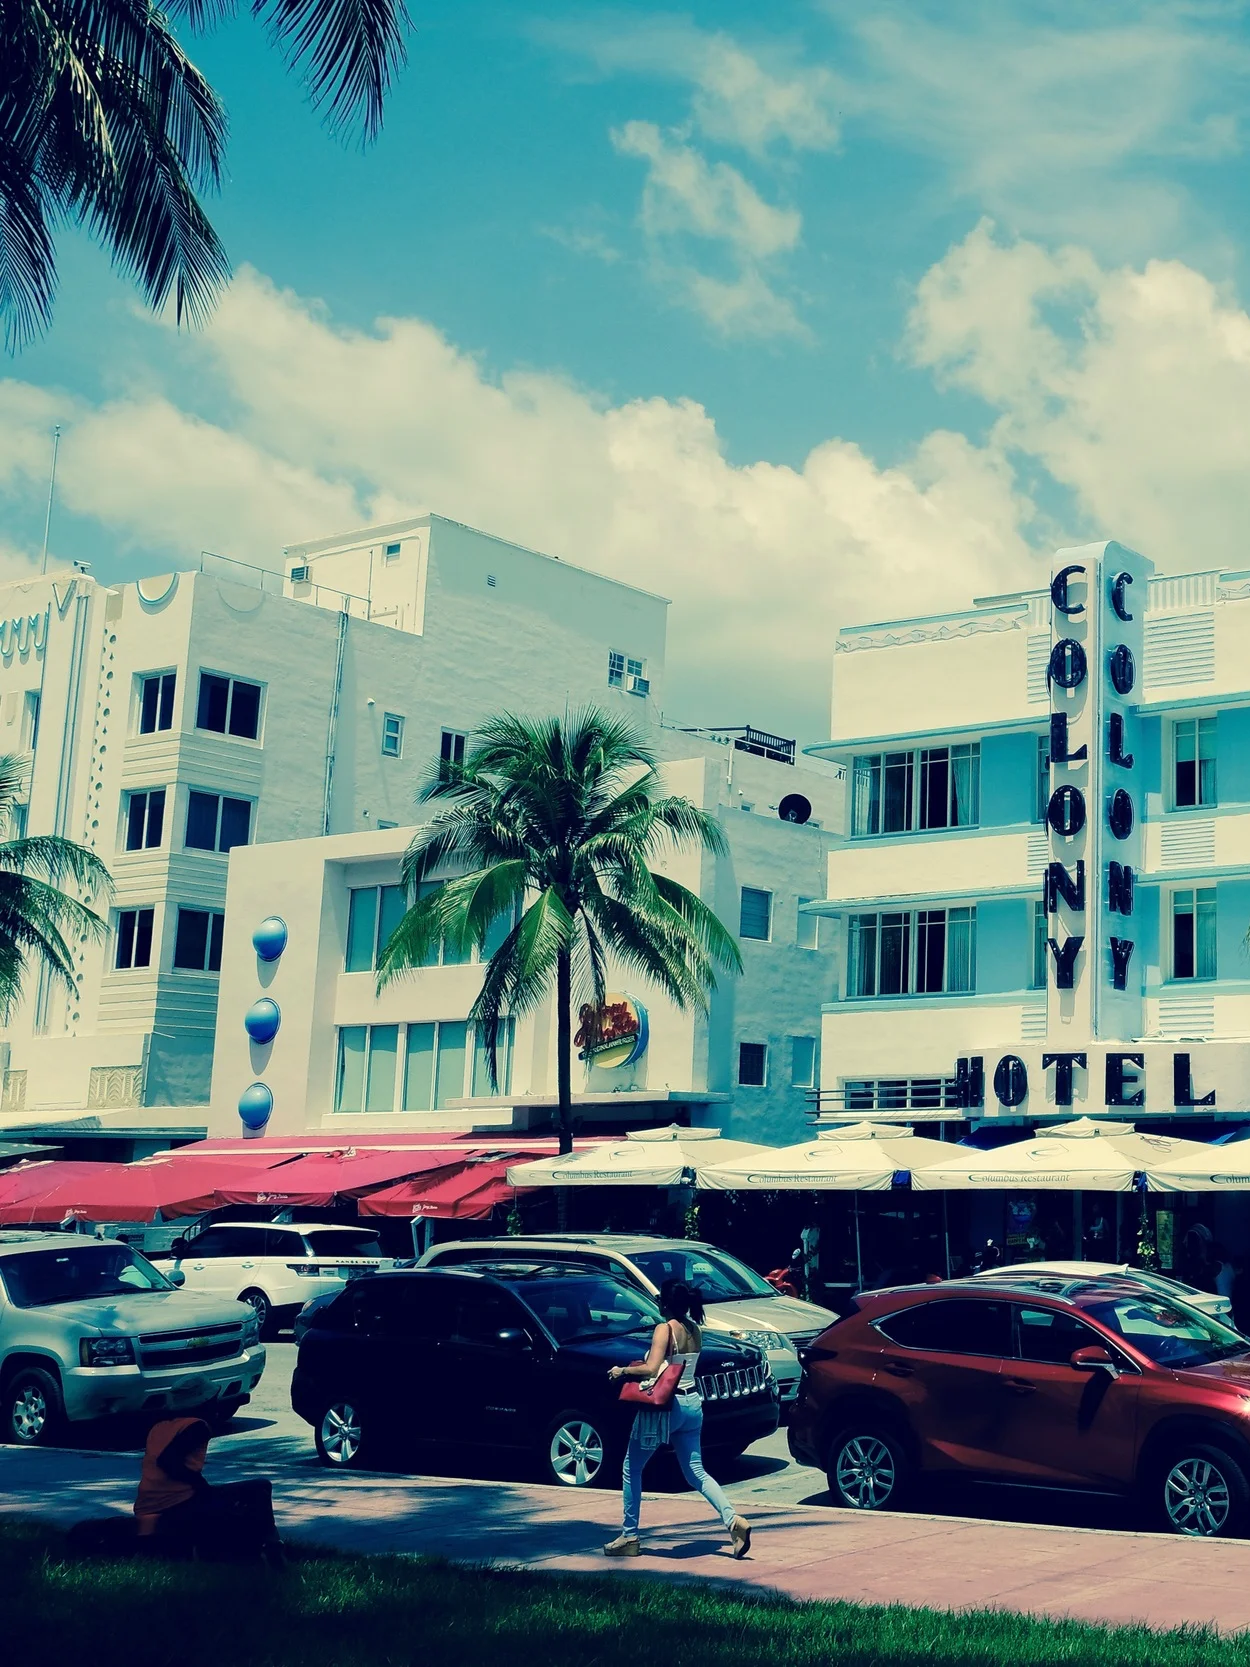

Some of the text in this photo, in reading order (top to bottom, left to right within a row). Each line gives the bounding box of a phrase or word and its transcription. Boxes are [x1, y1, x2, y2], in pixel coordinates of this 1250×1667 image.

[1048, 565, 1088, 989] COLONY
[1110, 571, 1136, 990] COLONY
[957, 1053, 1216, 1108] HOTEL
